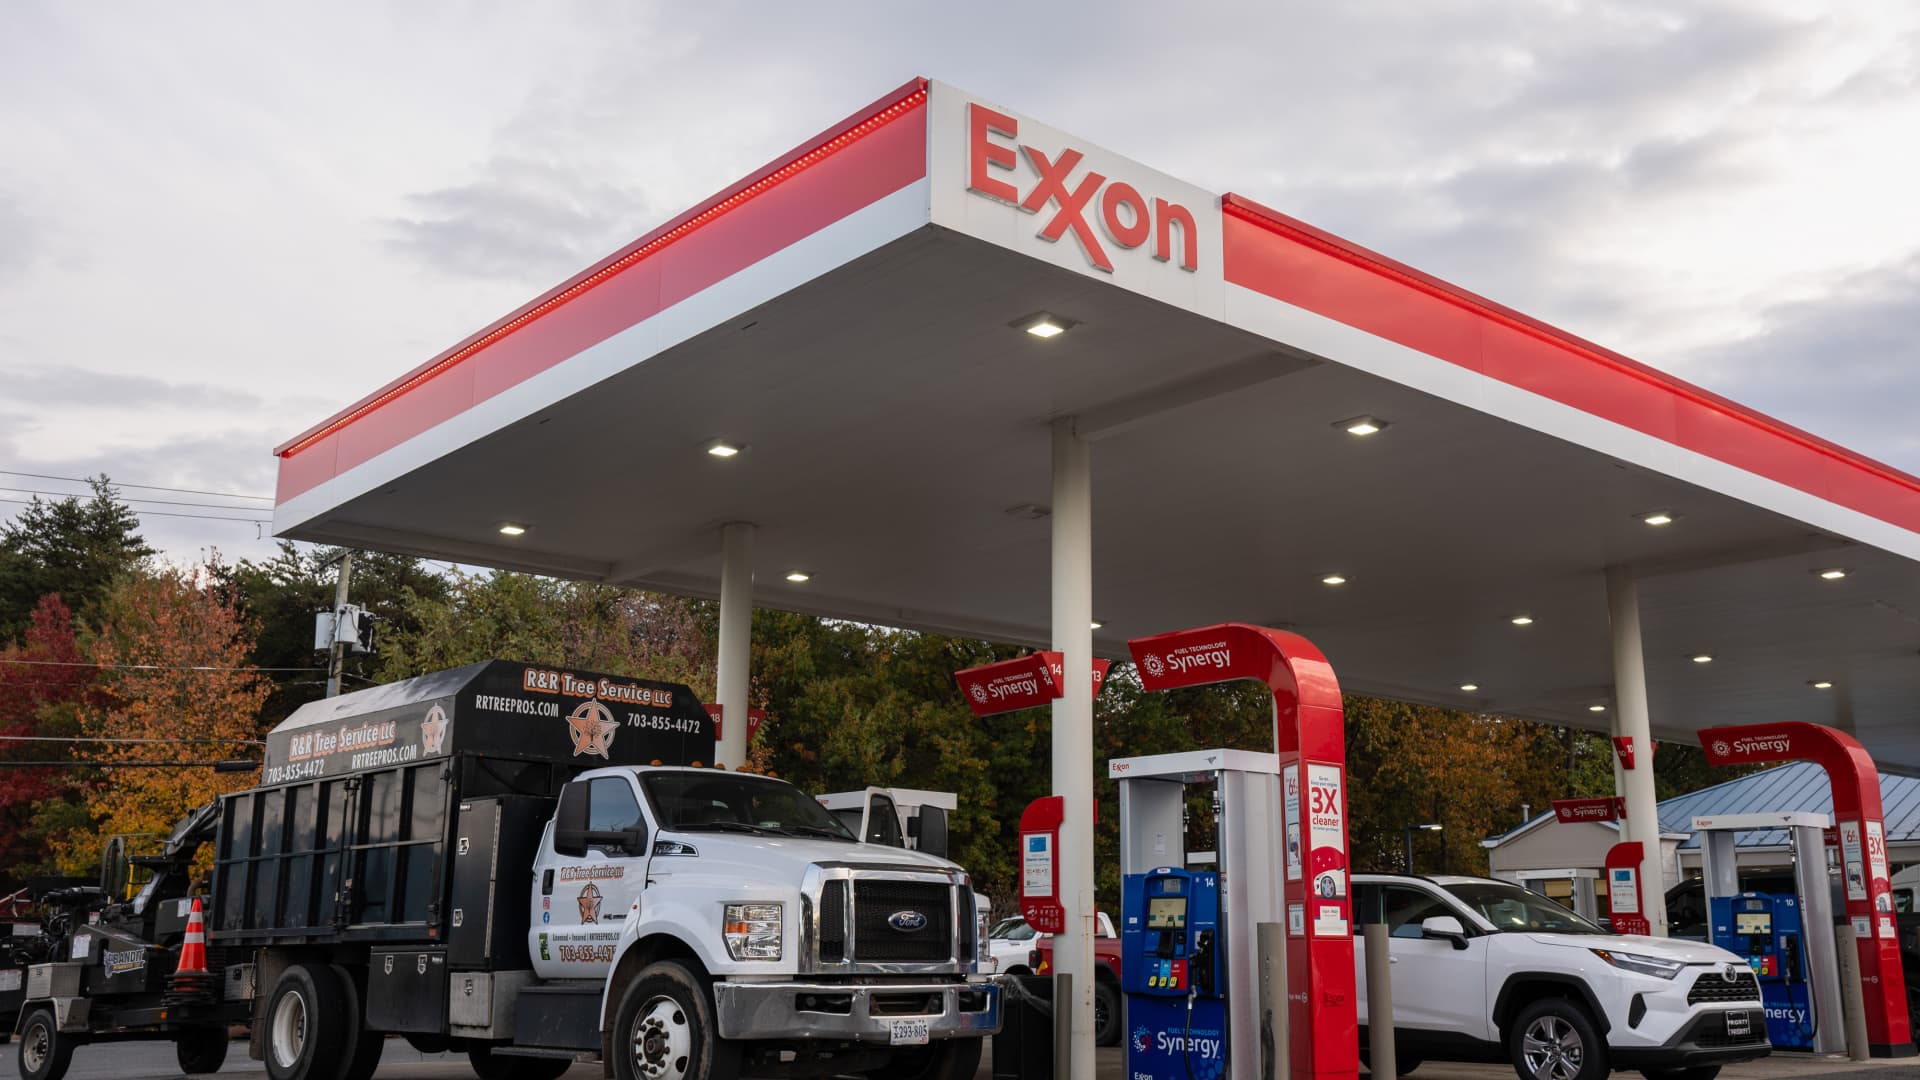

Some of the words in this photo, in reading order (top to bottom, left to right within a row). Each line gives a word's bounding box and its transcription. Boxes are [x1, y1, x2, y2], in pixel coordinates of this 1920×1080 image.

[966, 102, 1198, 273] Exxon
[1174, 647, 1188, 655] FUEL
[1189, 641, 1227, 652] TECHNOLOGY
[1050, 663, 1062, 675] 14
[1166, 649, 1230, 673] Synergy
[1092, 669, 1102, 682] 13
[526, 669, 560, 691] R&R
[564, 674, 596, 695] Tree
[600, 679, 651, 702] Service
[654, 690, 671, 705] LLC
[987, 679, 1038, 701] Synergy
[475, 694, 559, 718] RRTREEPROS.COM
[627, 712, 700, 734] 703-855-4472
[749, 716, 758, 726] 17
[290, 734, 312, 757] R&R
[315, 733, 337, 752] Tree
[339, 724, 379, 748] Service
[380, 721, 396, 740] LLC
[1733, 739, 1790, 755] Synergy
[351, 744, 417, 769] RRTREEPROS.COM
[267, 759, 325, 784] 703-855-4472
[1112, 763, 1129, 772] Exxon
[1311, 786, 1338, 815] 3X
[1312, 815, 1339, 827] cleaner
[1573, 808, 1608, 817] Synergy
[1869, 836, 1883, 856] 3X
[1204, 877, 1215, 887] 14
[1785, 899, 1794, 907] 10
[900, 913, 920, 927] Ford
[899, 1024, 928, 1038] 293-805
[1157, 1031, 1220, 1058] Synergy
